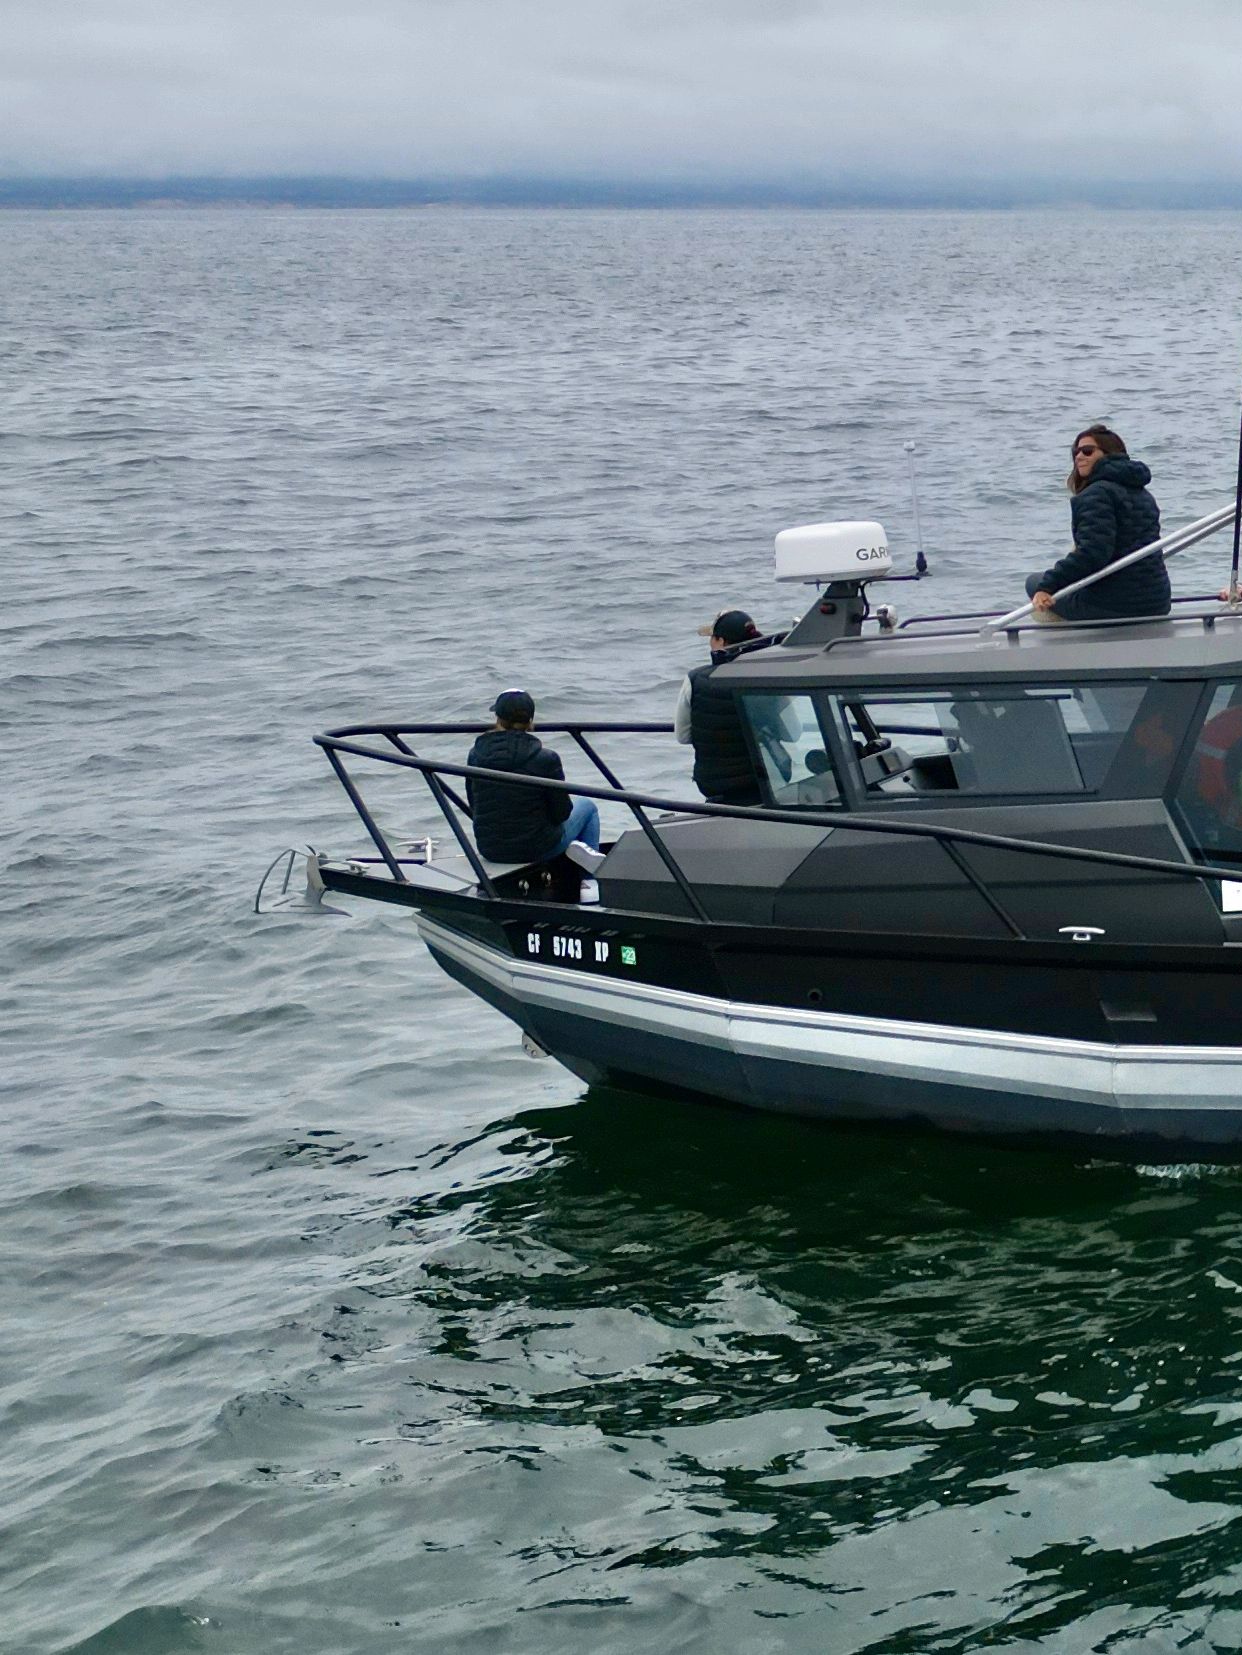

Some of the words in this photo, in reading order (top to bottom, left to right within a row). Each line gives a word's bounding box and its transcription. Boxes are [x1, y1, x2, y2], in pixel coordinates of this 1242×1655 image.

[856, 546, 888, 561] GAR
[527, 933, 541, 953] CF
[594, 941, 609, 962] XP
